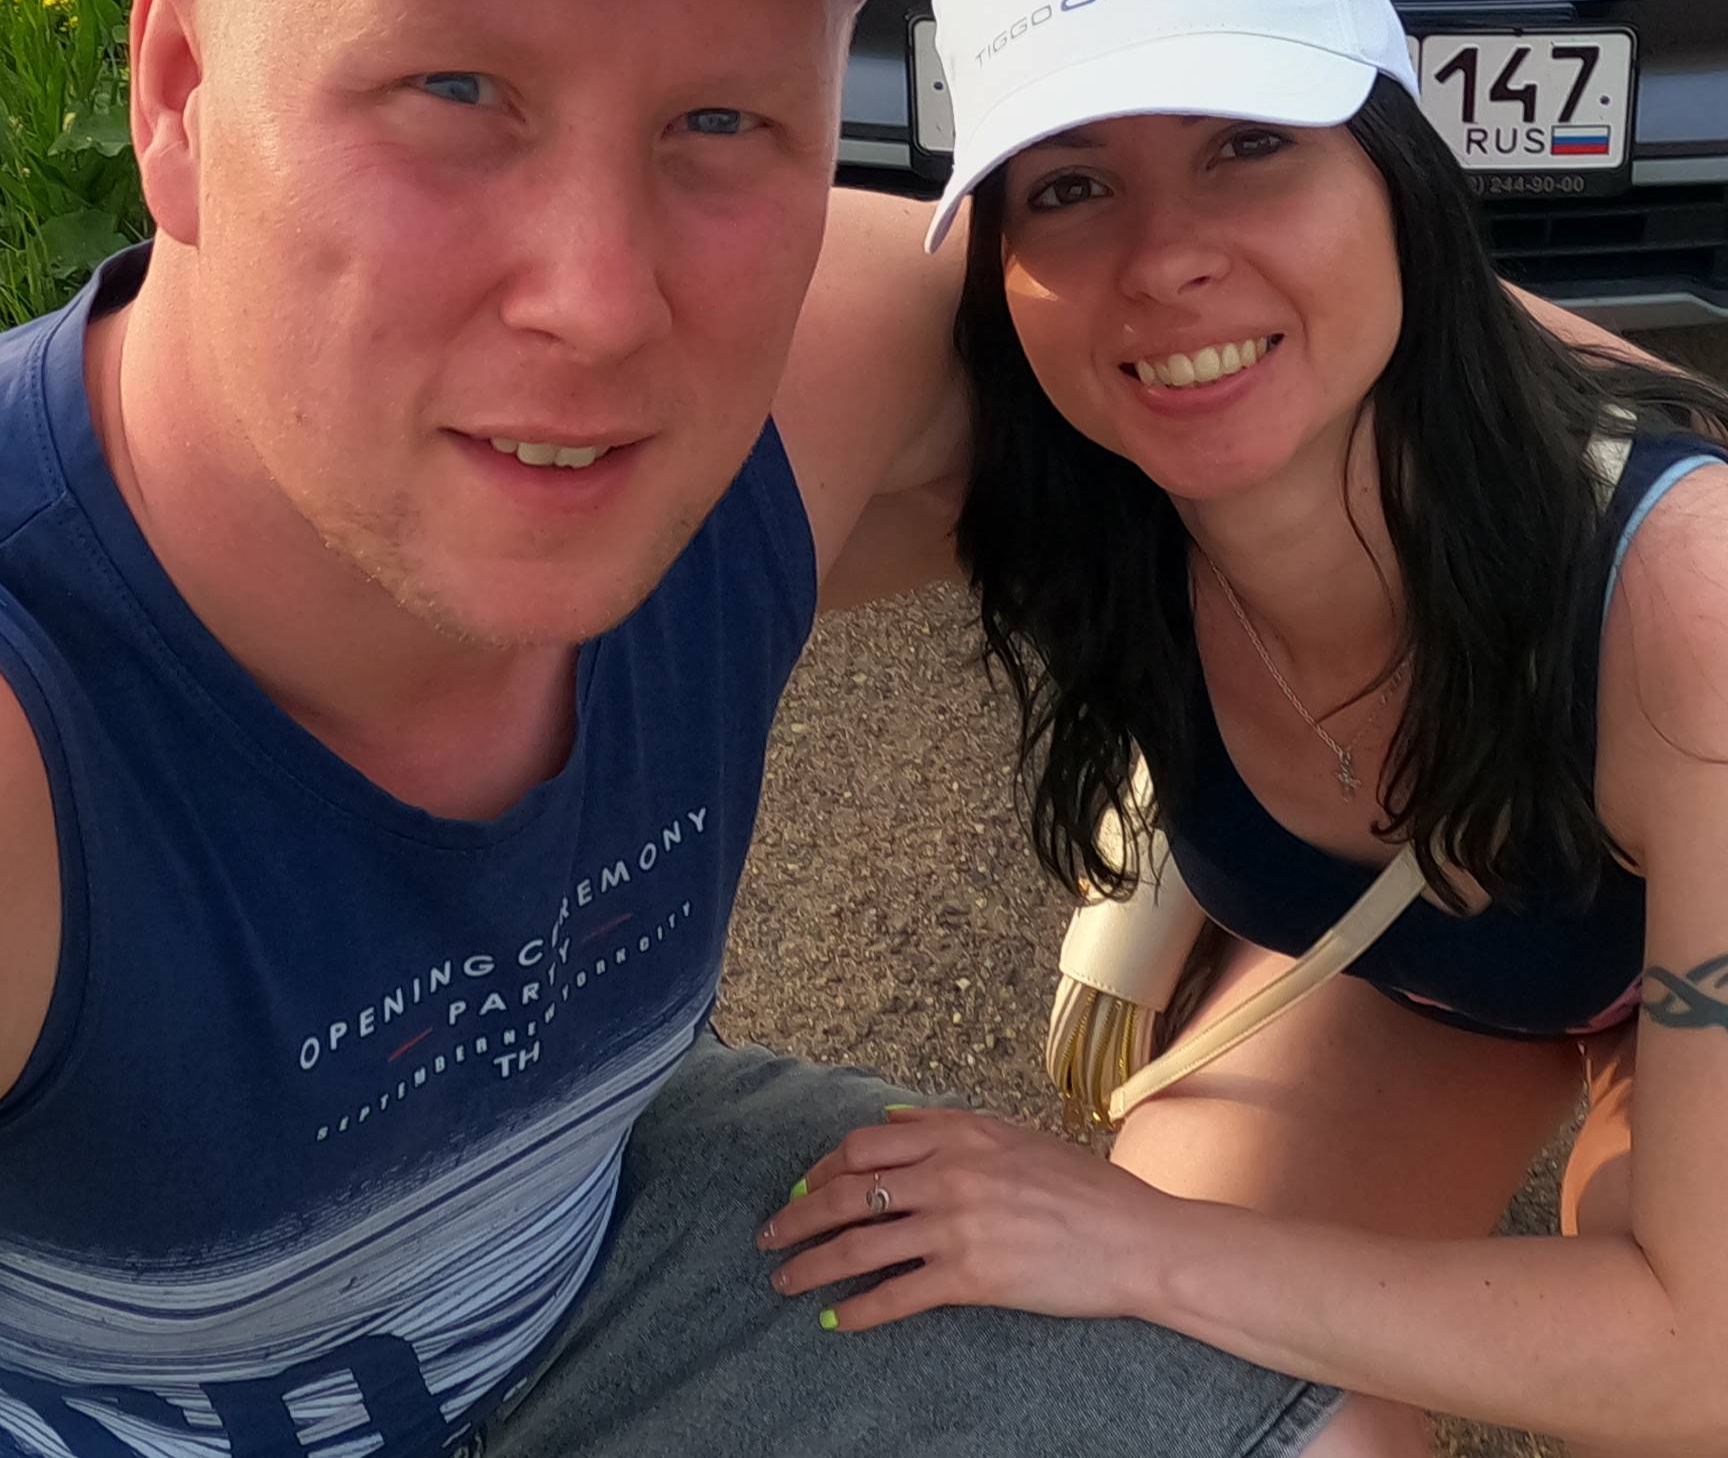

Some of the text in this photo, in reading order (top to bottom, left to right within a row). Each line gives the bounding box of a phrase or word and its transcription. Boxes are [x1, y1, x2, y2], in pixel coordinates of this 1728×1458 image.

[974, 4, 1054, 69] TIGGO
[1433, 45, 1602, 125] 147
[1465, 126, 1546, 157] RUS
[1488, 175, 1586, 194] 244-90-00
[298, 952, 496, 1071] OPENING
[316, 1029, 489, 1142] SEPTEMBER
[493, 1039, 541, 1080] TH
